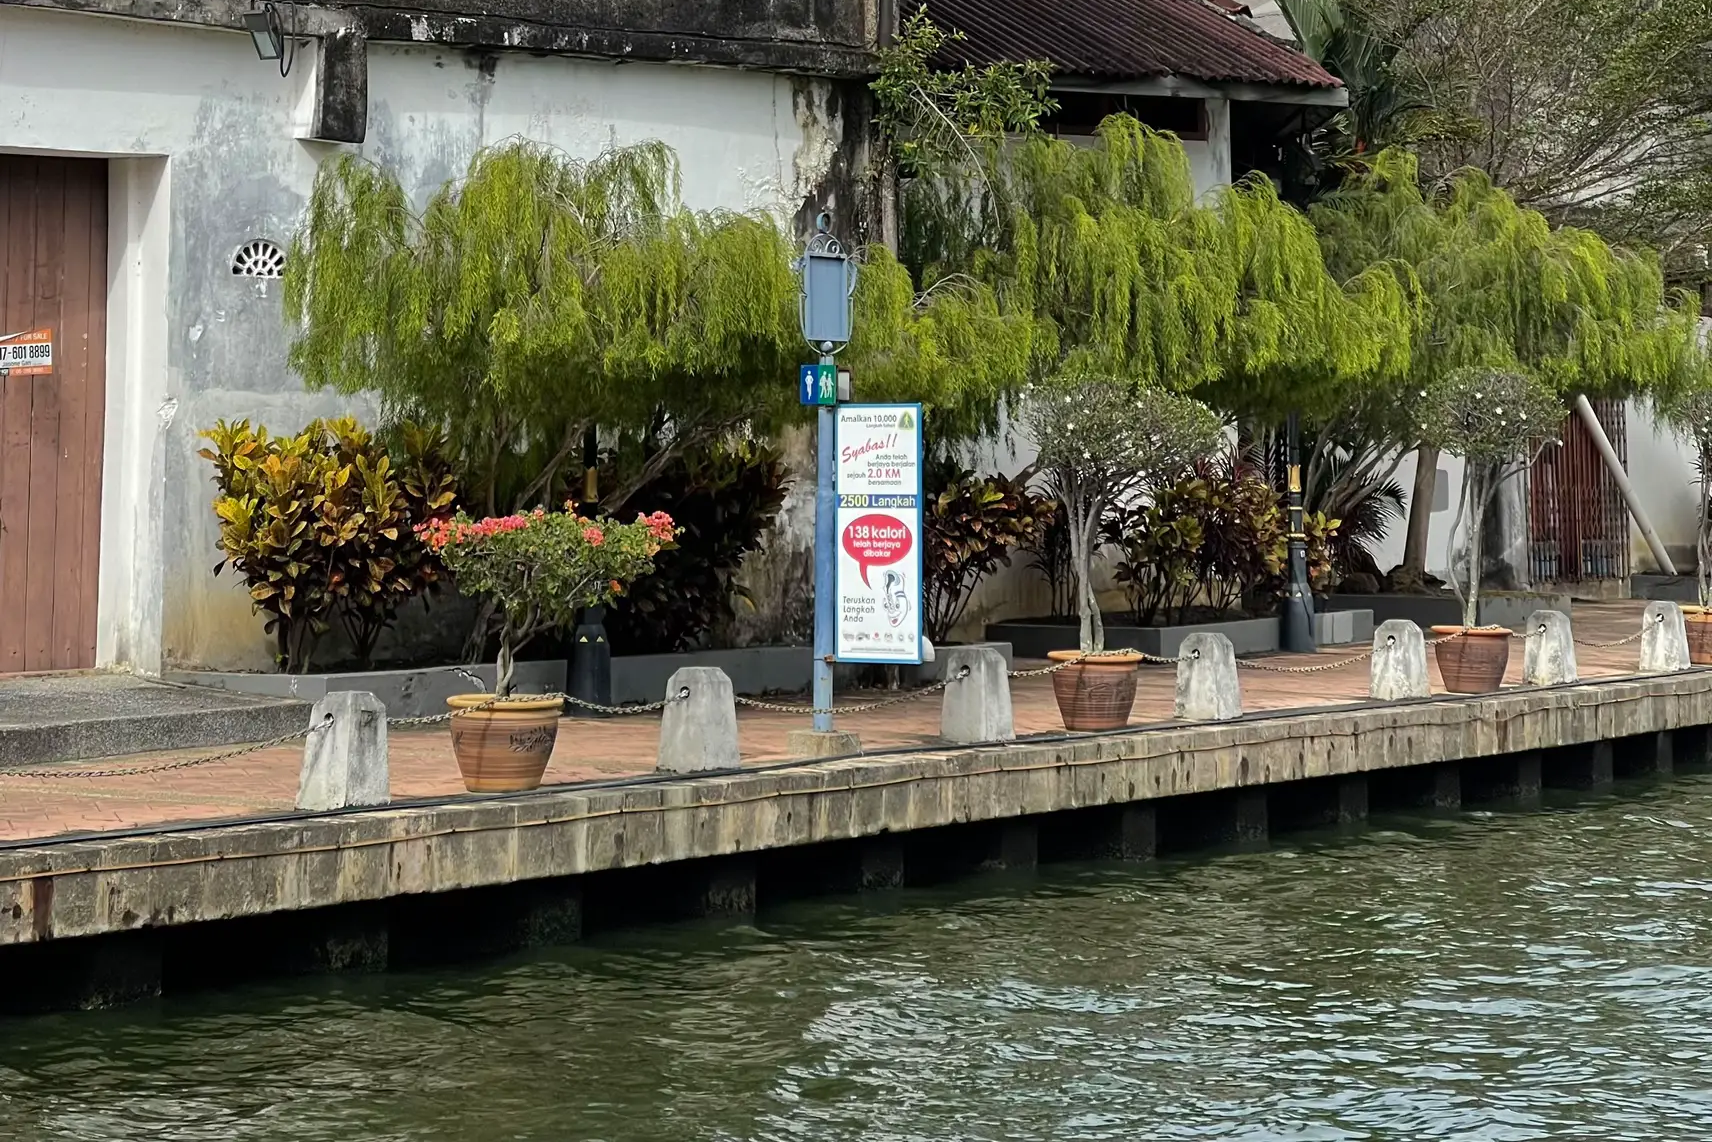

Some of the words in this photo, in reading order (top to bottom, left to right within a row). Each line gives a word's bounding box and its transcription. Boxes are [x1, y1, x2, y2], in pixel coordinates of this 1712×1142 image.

[29, 344, 50, 358] 8899
[841, 414, 871, 422] Amalkan
[874, 414, 897, 423] 10,000
[842, 433, 897, 463] Syabas!!
[847, 471, 866, 479] sejauh
[868, 468, 882, 478] 2.0
[885, 468, 901, 478] KM
[840, 494, 869, 507] 2500
[871, 495, 915, 508] Langkah
[848, 525, 869, 538] 138
[871, 525, 906, 539] kalori
[853, 540, 871, 548] telah
[873, 540, 901, 550] berjaya
[863, 549, 891, 557] dibakar
[843, 596, 875, 604] Teruskan
[843, 605, 875, 615] Langkah
